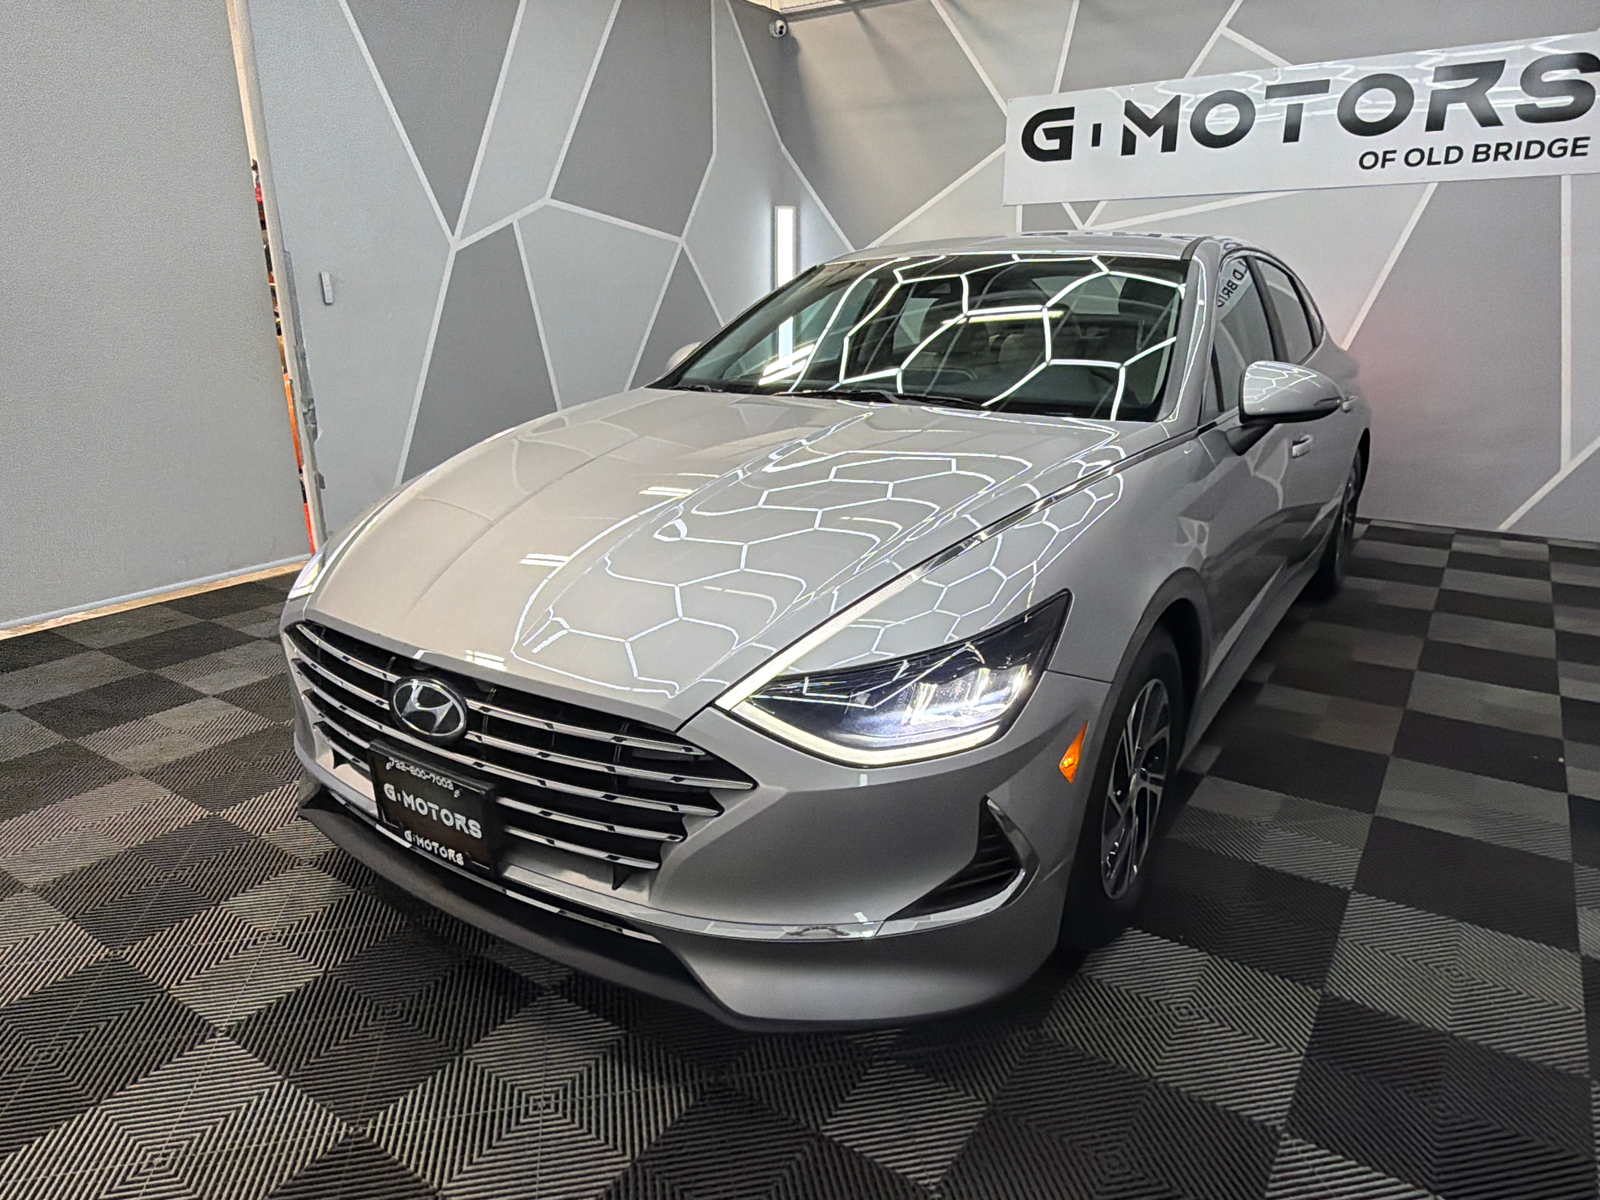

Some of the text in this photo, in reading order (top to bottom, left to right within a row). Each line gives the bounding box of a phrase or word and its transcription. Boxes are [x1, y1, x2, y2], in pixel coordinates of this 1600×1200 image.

[1358, 135, 1591, 170] OF OLD BRIDGE
